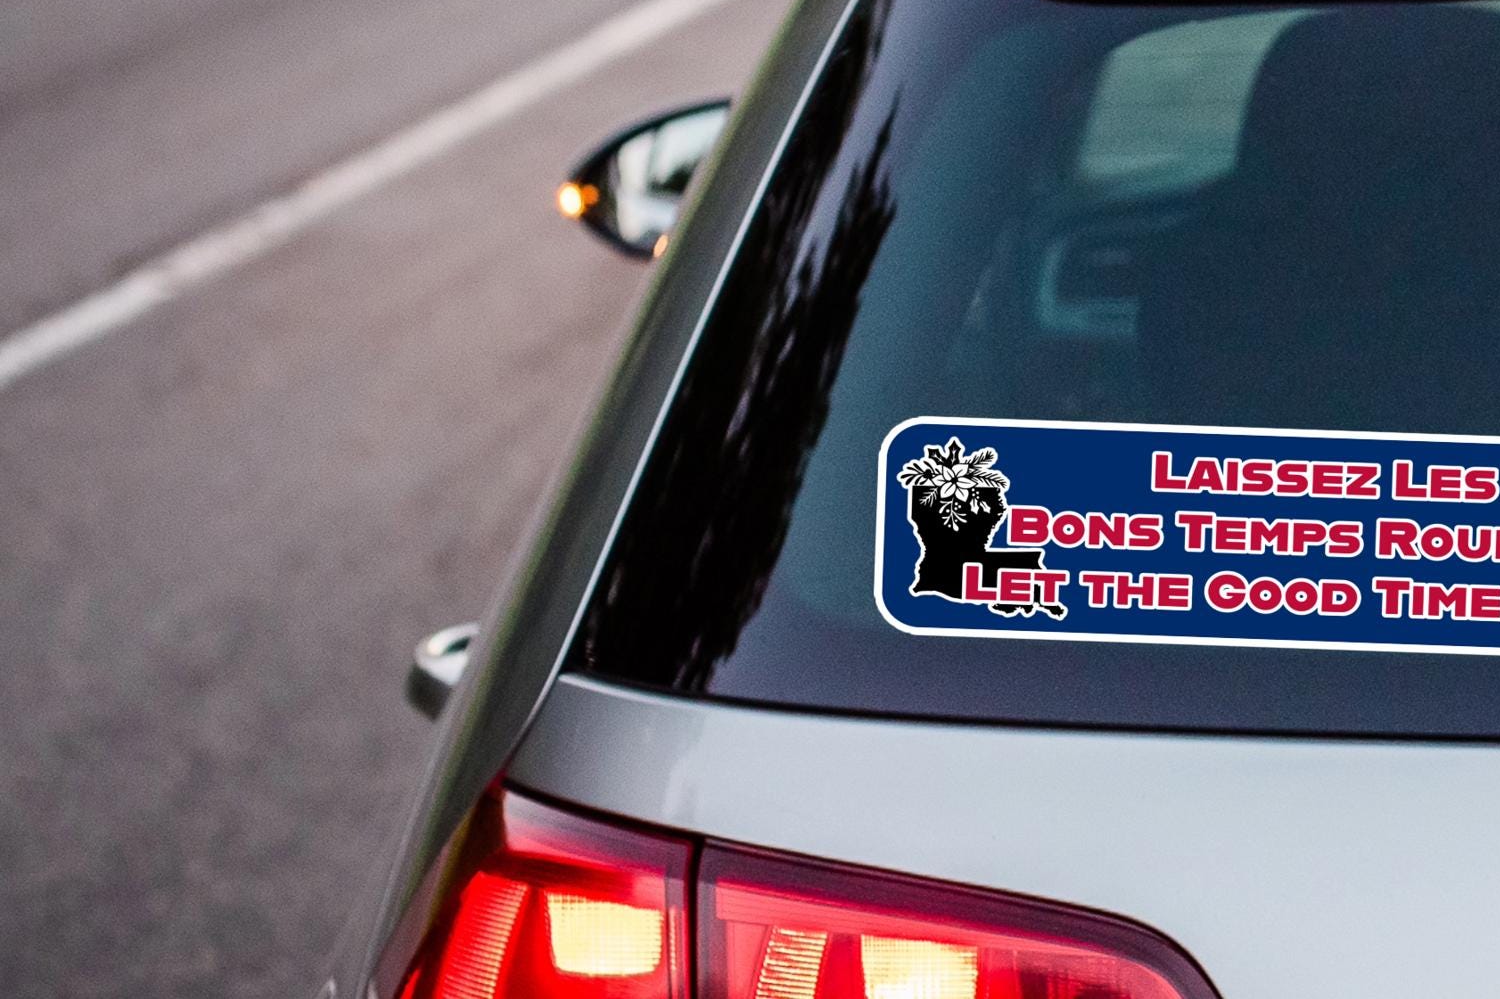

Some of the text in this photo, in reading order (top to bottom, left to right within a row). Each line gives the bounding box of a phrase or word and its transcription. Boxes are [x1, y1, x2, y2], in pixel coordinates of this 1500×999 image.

[1154, 454, 1498, 501] LAISSEZ LES
[1009, 507, 1162, 548] BONS
[1177, 513, 1362, 555] TEMPS
[964, 564, 1068, 604] LET
[1081, 573, 1190, 608] THE
[1206, 573, 1359, 614] GOOD
